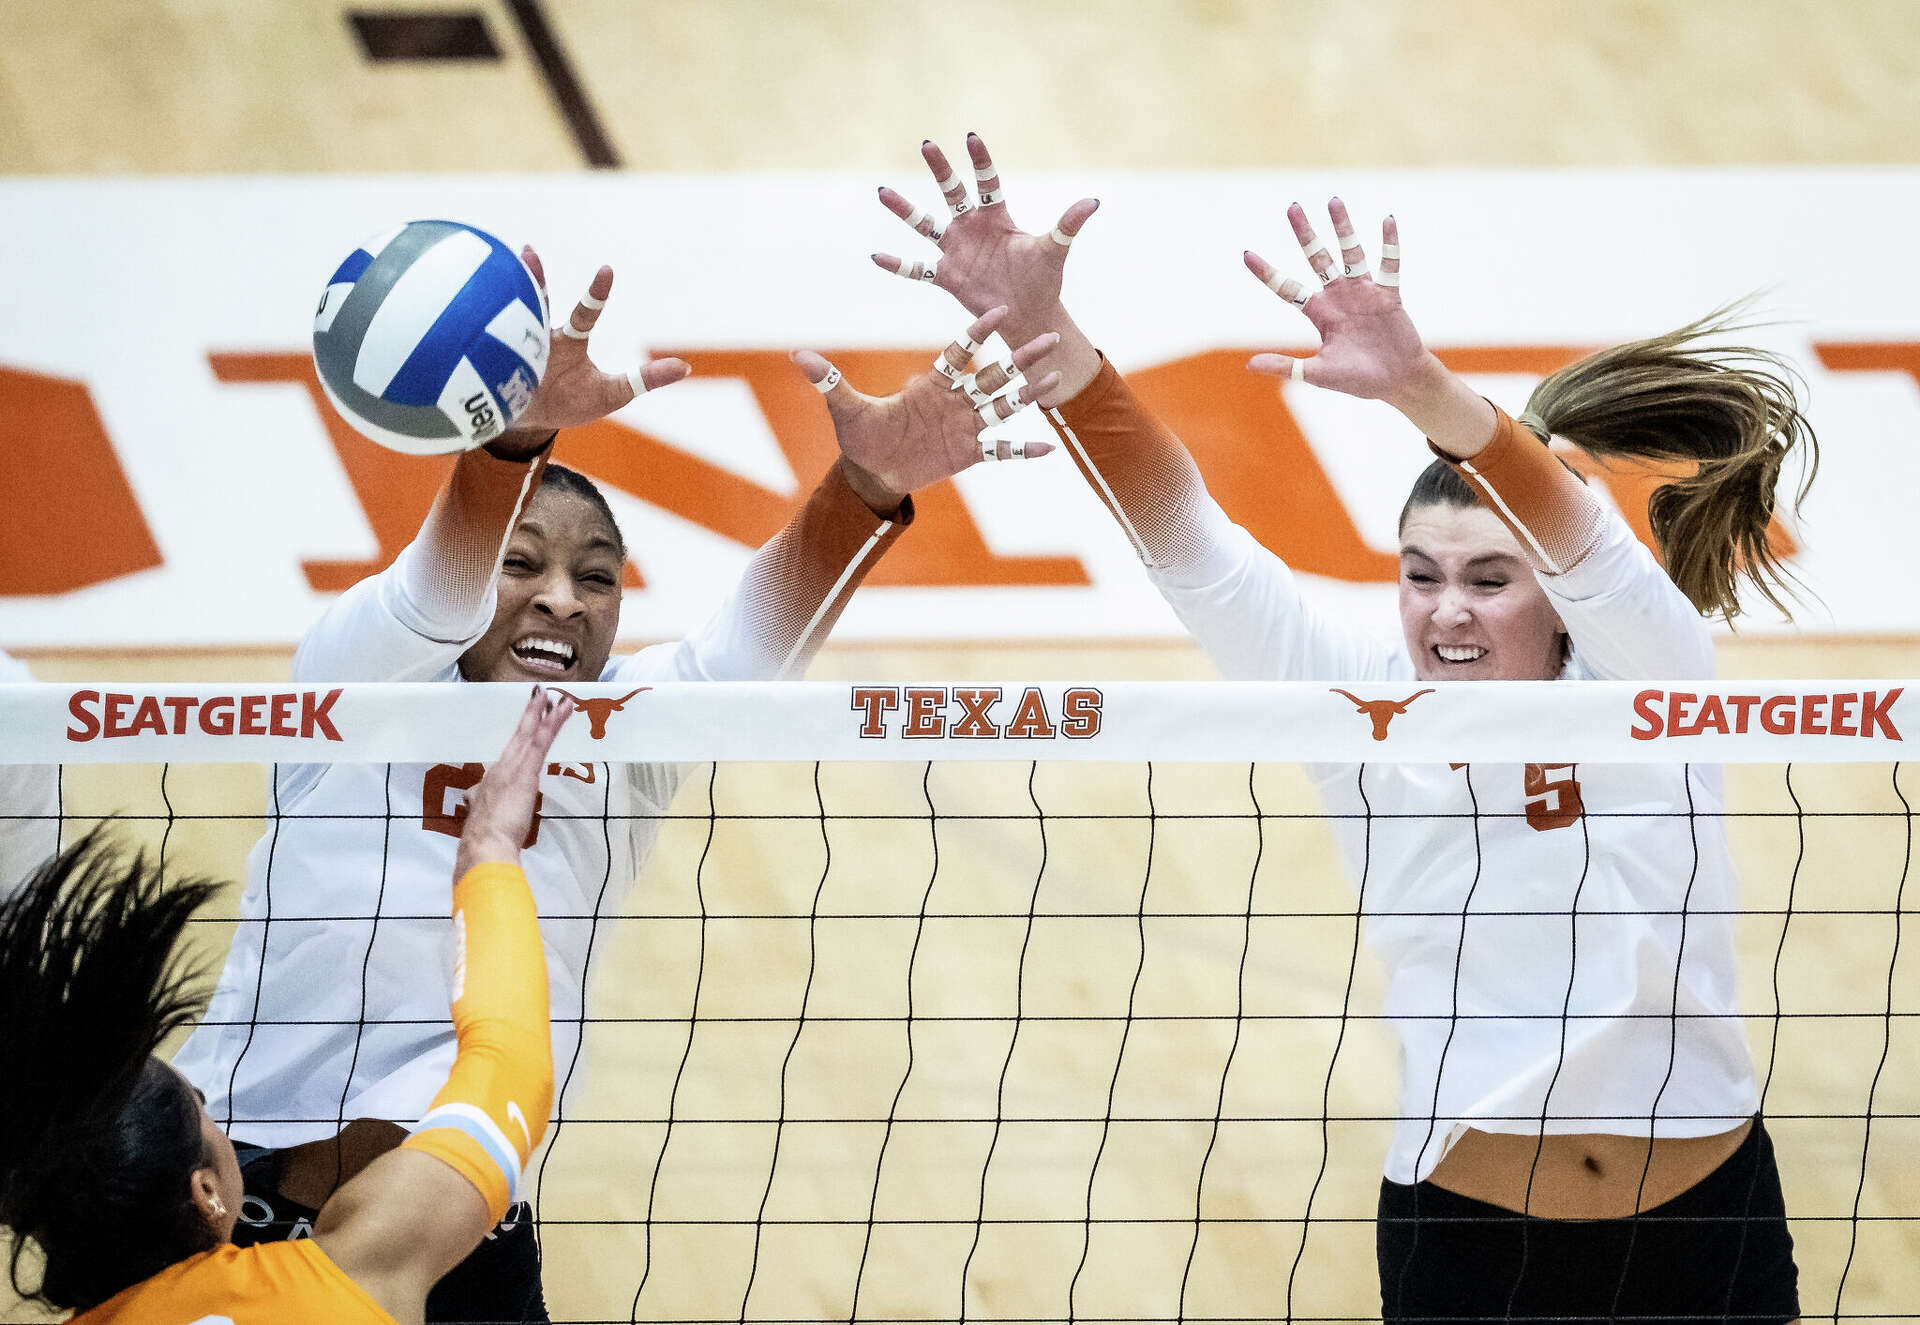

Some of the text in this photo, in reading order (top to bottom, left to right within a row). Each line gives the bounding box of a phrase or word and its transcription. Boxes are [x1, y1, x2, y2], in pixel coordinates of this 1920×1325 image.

[67, 689, 344, 742] SEATGEEK
[851, 686, 1103, 739] TEXAS
[1631, 688, 1904, 741] SEATGEEK
[1525, 763, 1583, 832] 5
